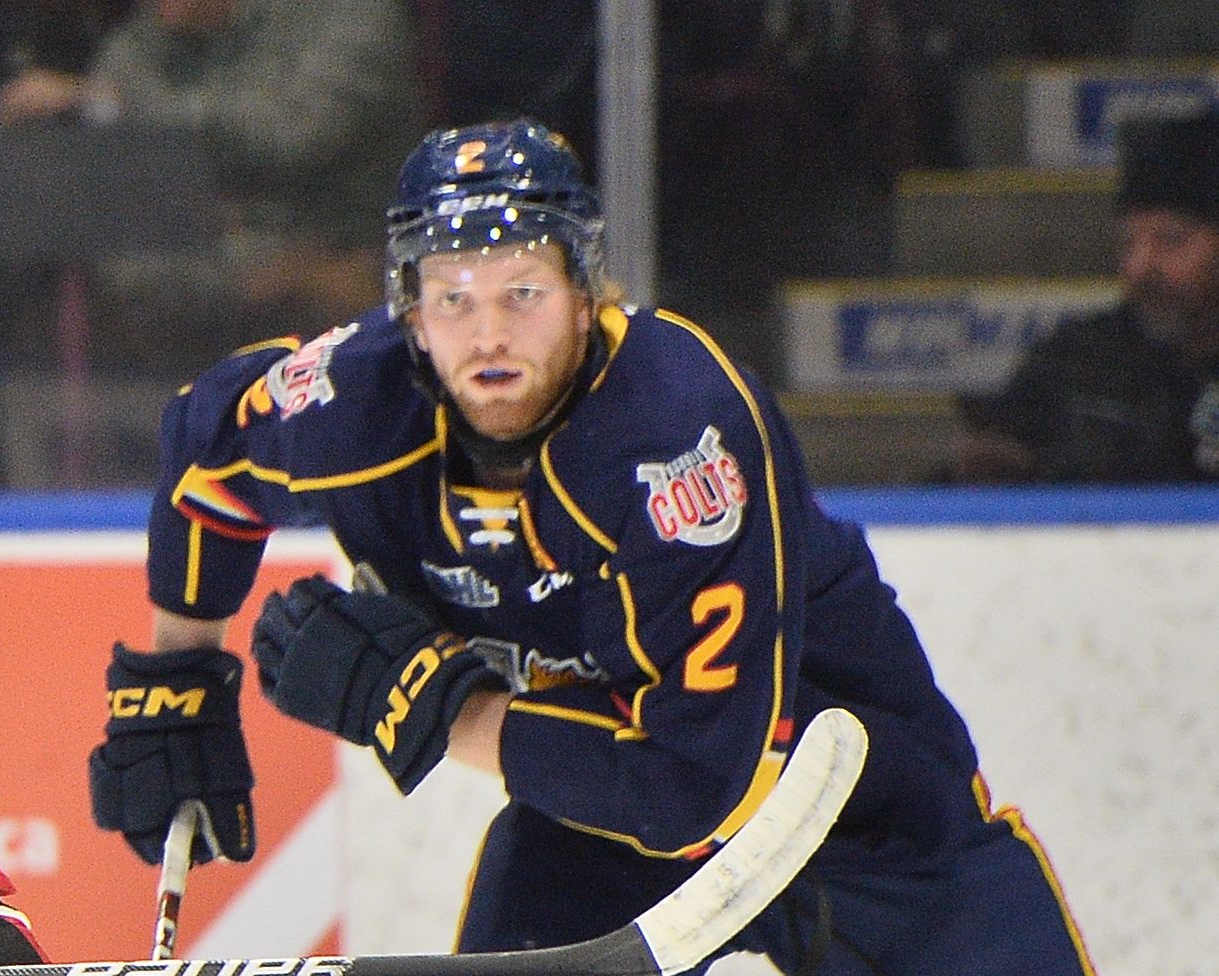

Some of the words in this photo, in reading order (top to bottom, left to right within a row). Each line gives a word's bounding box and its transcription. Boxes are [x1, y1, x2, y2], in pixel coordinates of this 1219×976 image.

[455, 140, 487, 174] 2
[648, 453, 748, 541] COLTS
[683, 580, 747, 693] 2
